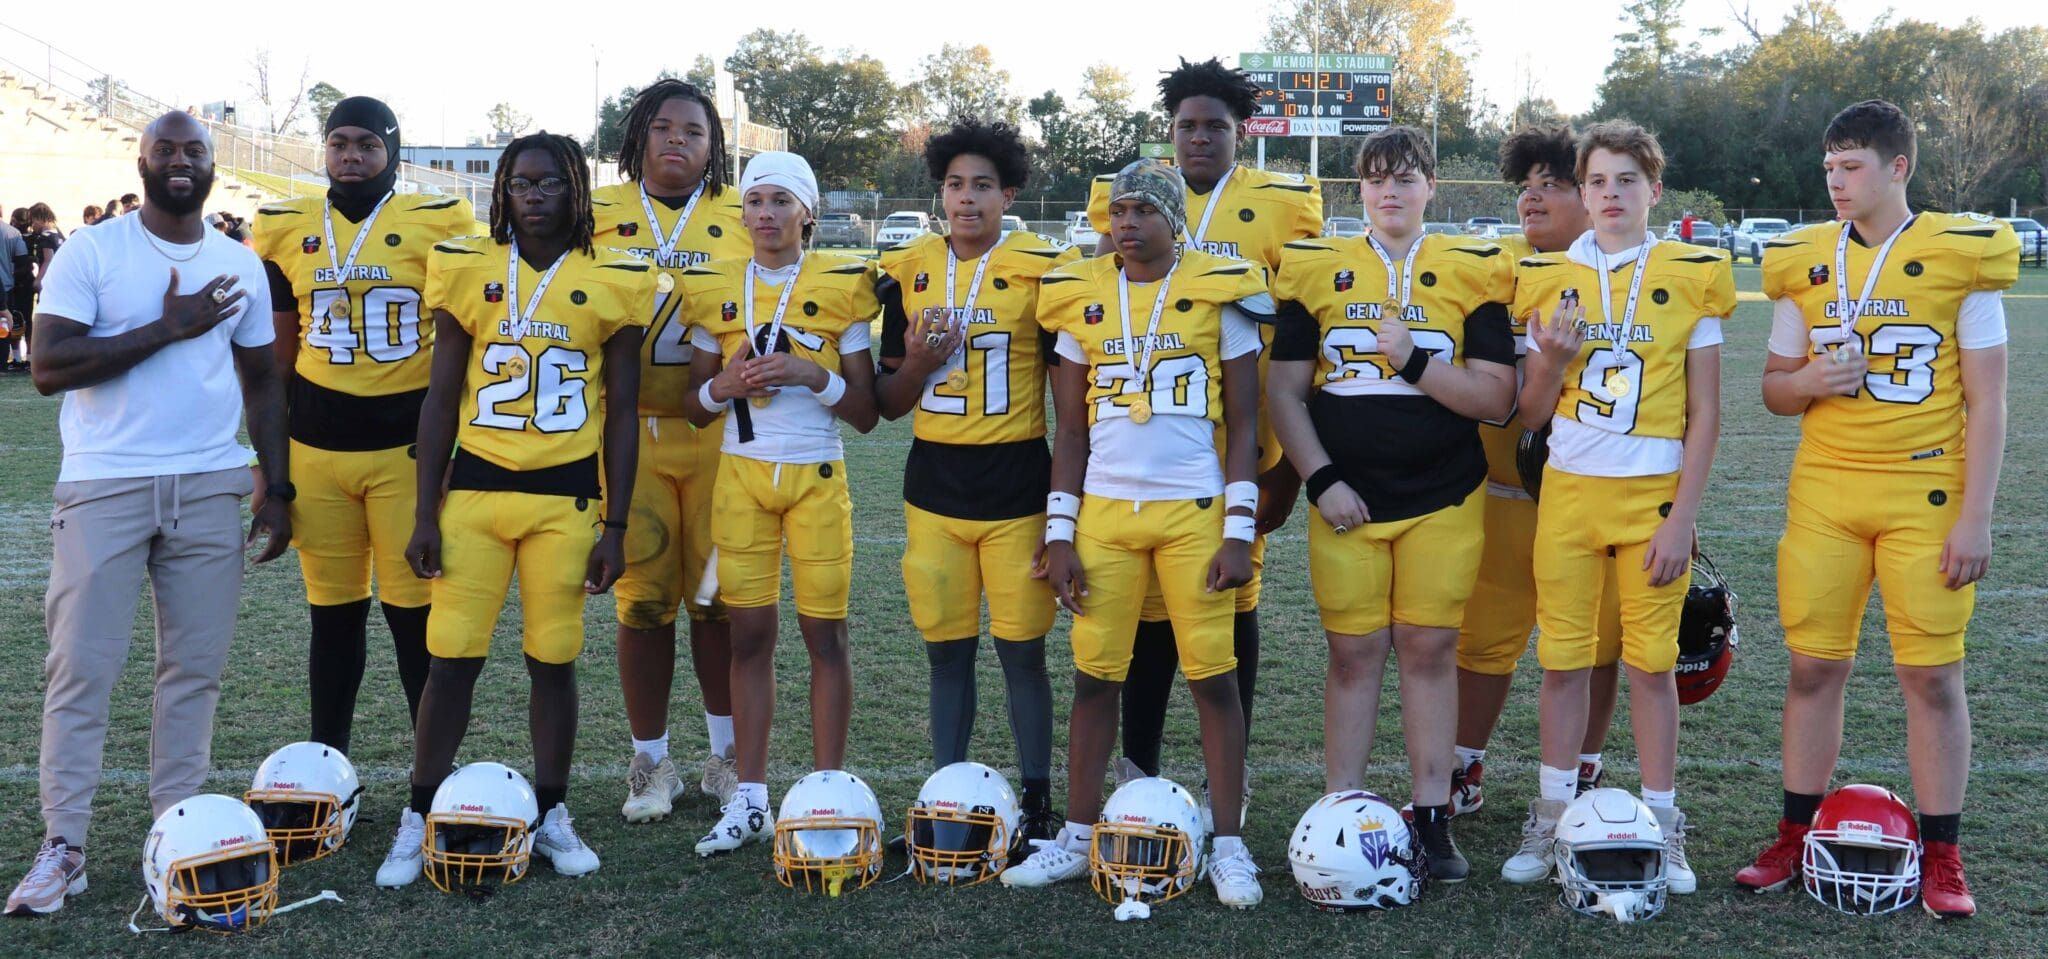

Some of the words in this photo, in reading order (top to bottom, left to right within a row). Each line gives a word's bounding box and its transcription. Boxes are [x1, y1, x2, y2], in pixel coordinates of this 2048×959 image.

[1273, 55, 1332, 68] MEMORAL
[1336, 56, 1386, 69] STADIUM
[1353, 74, 1390, 84] VISITOR
[1284, 103, 1297, 117] 10
[1297, 104, 1309, 115] TO
[1330, 104, 1342, 115] ON
[1363, 105, 1380, 117] QTR
[1381, 105, 1390, 118] 4
[315, 265, 393, 283] CETRAL
[1345, 302, 1428, 323] CENAL
[1825, 298, 1910, 318] CNTRAL
[306, 286, 422, 365] 40
[498, 319, 571, 342] CNTRAL
[1584, 323, 1655, 342] ENTAL
[469, 342, 589, 434] 26
[1576, 346, 1645, 435] 9
[1675, 660, 1710, 673] Ridd
[460, 803, 484, 812] Riddell
[935, 800, 958, 809] Riddell
[811, 808, 835, 816] Riddell
[1124, 815, 1146, 823] Riddell
[1848, 822, 1872, 831] Riddell
[220, 835, 245, 848] Riddell
[1607, 832, 1637, 840] Riddell
